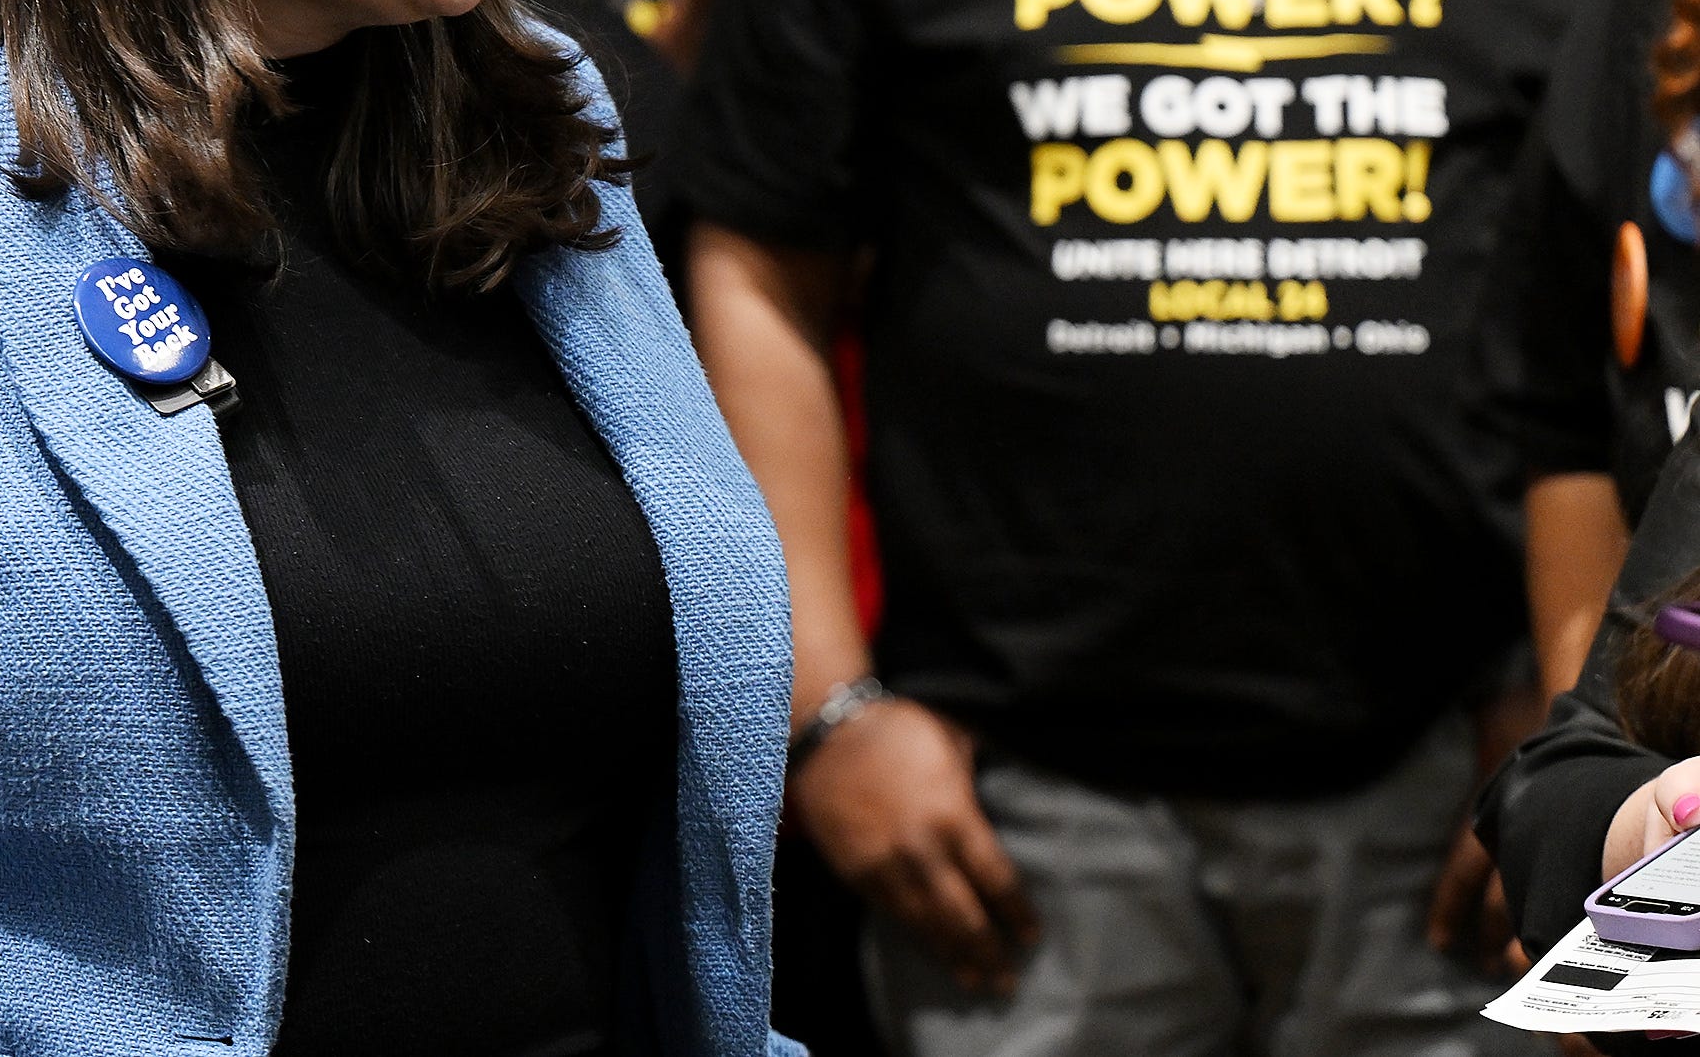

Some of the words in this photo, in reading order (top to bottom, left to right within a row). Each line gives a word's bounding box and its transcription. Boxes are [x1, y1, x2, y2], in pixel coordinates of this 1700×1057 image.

[1009, 74, 1132, 140] WE
[1141, 75, 1295, 138] GOT
[1302, 74, 1450, 138] THE
[1030, 138, 1432, 227] POWER!
[1052, 239, 1161, 280] UNITE
[1164, 239, 1265, 279] HERE
[1267, 237, 1427, 280] DETROIT
[95, 268, 146, 301] I've
[113, 285, 161, 319] Got
[1148, 279, 1275, 322] LOCAL
[118, 303, 181, 345] Your
[132, 324, 198, 368] Back
